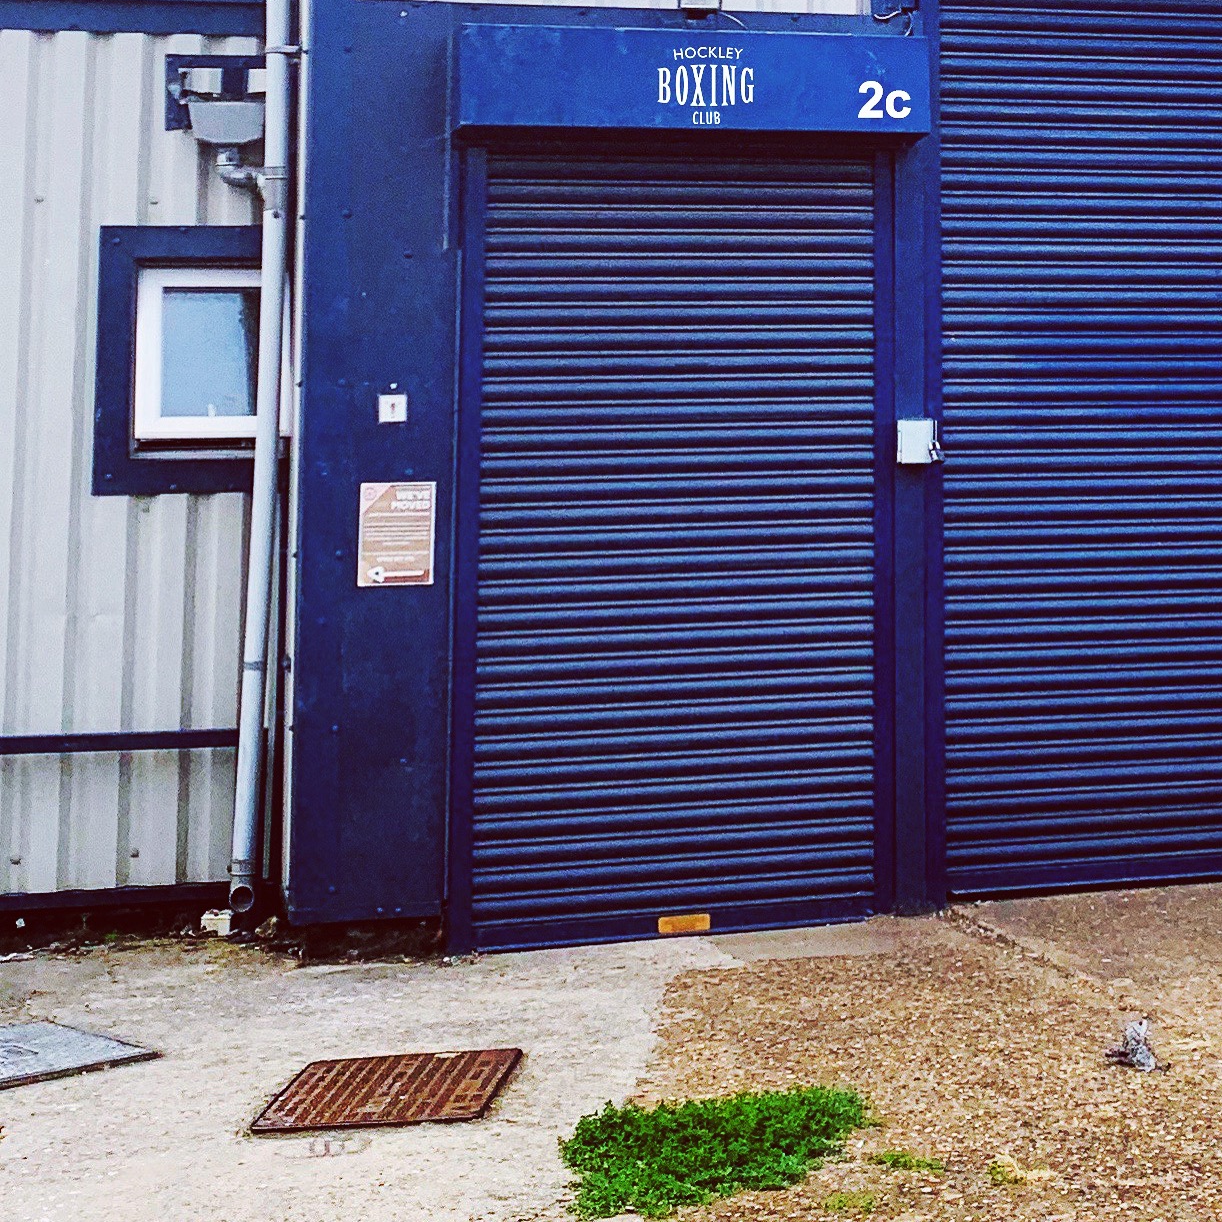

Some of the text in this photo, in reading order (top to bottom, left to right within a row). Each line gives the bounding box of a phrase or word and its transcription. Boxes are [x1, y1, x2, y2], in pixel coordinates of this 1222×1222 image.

[673, 46, 744, 61] HOCKLEY
[657, 64, 755, 107] BOXING
[857, 80, 912, 119] 2c
[692, 111, 721, 125] CLUB
